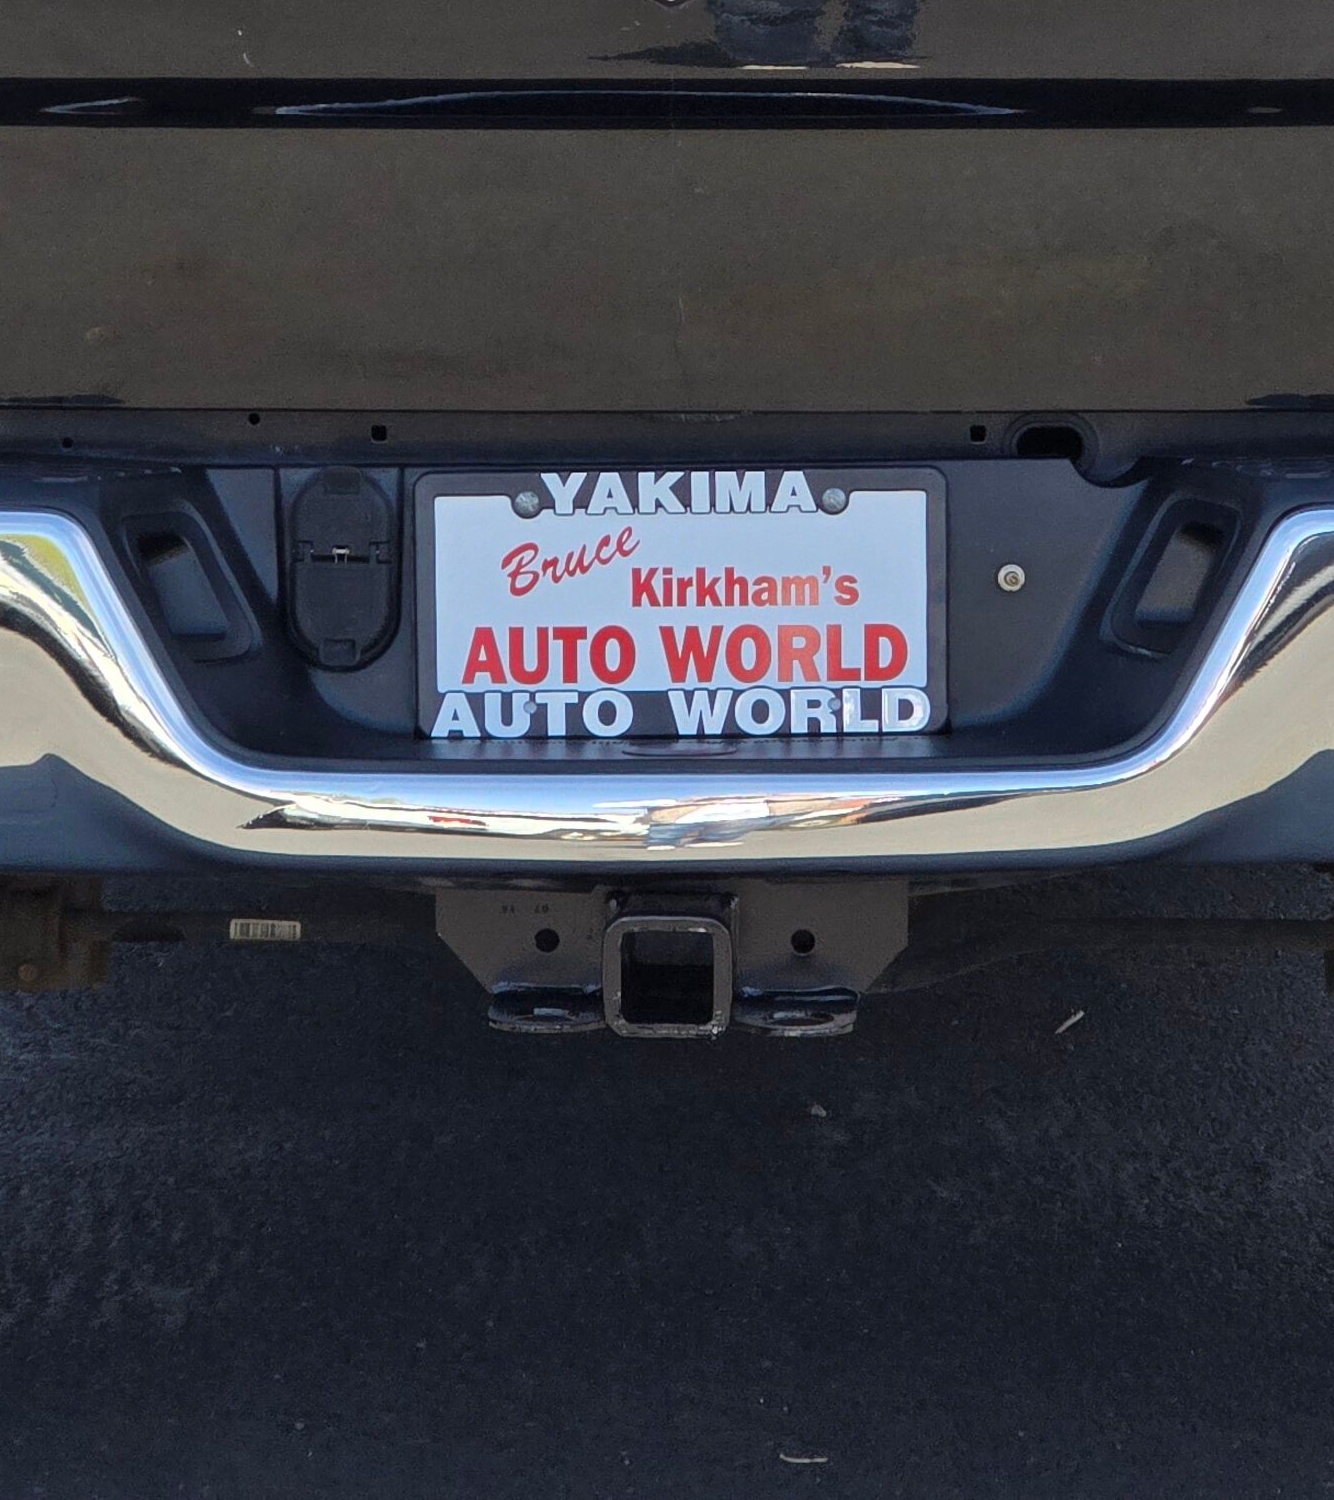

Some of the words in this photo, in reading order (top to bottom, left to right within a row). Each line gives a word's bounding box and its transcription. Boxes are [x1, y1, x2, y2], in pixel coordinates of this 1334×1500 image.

[540, 471, 818, 514] YAKIMA
[501, 526, 641, 596] Bruce
[631, 565, 860, 608] Kirkham's
[461, 624, 637, 685] AUTO
[658, 623, 908, 684] WORLD
[430, 690, 634, 738] AUTO
[667, 687, 931, 736] WORLD
